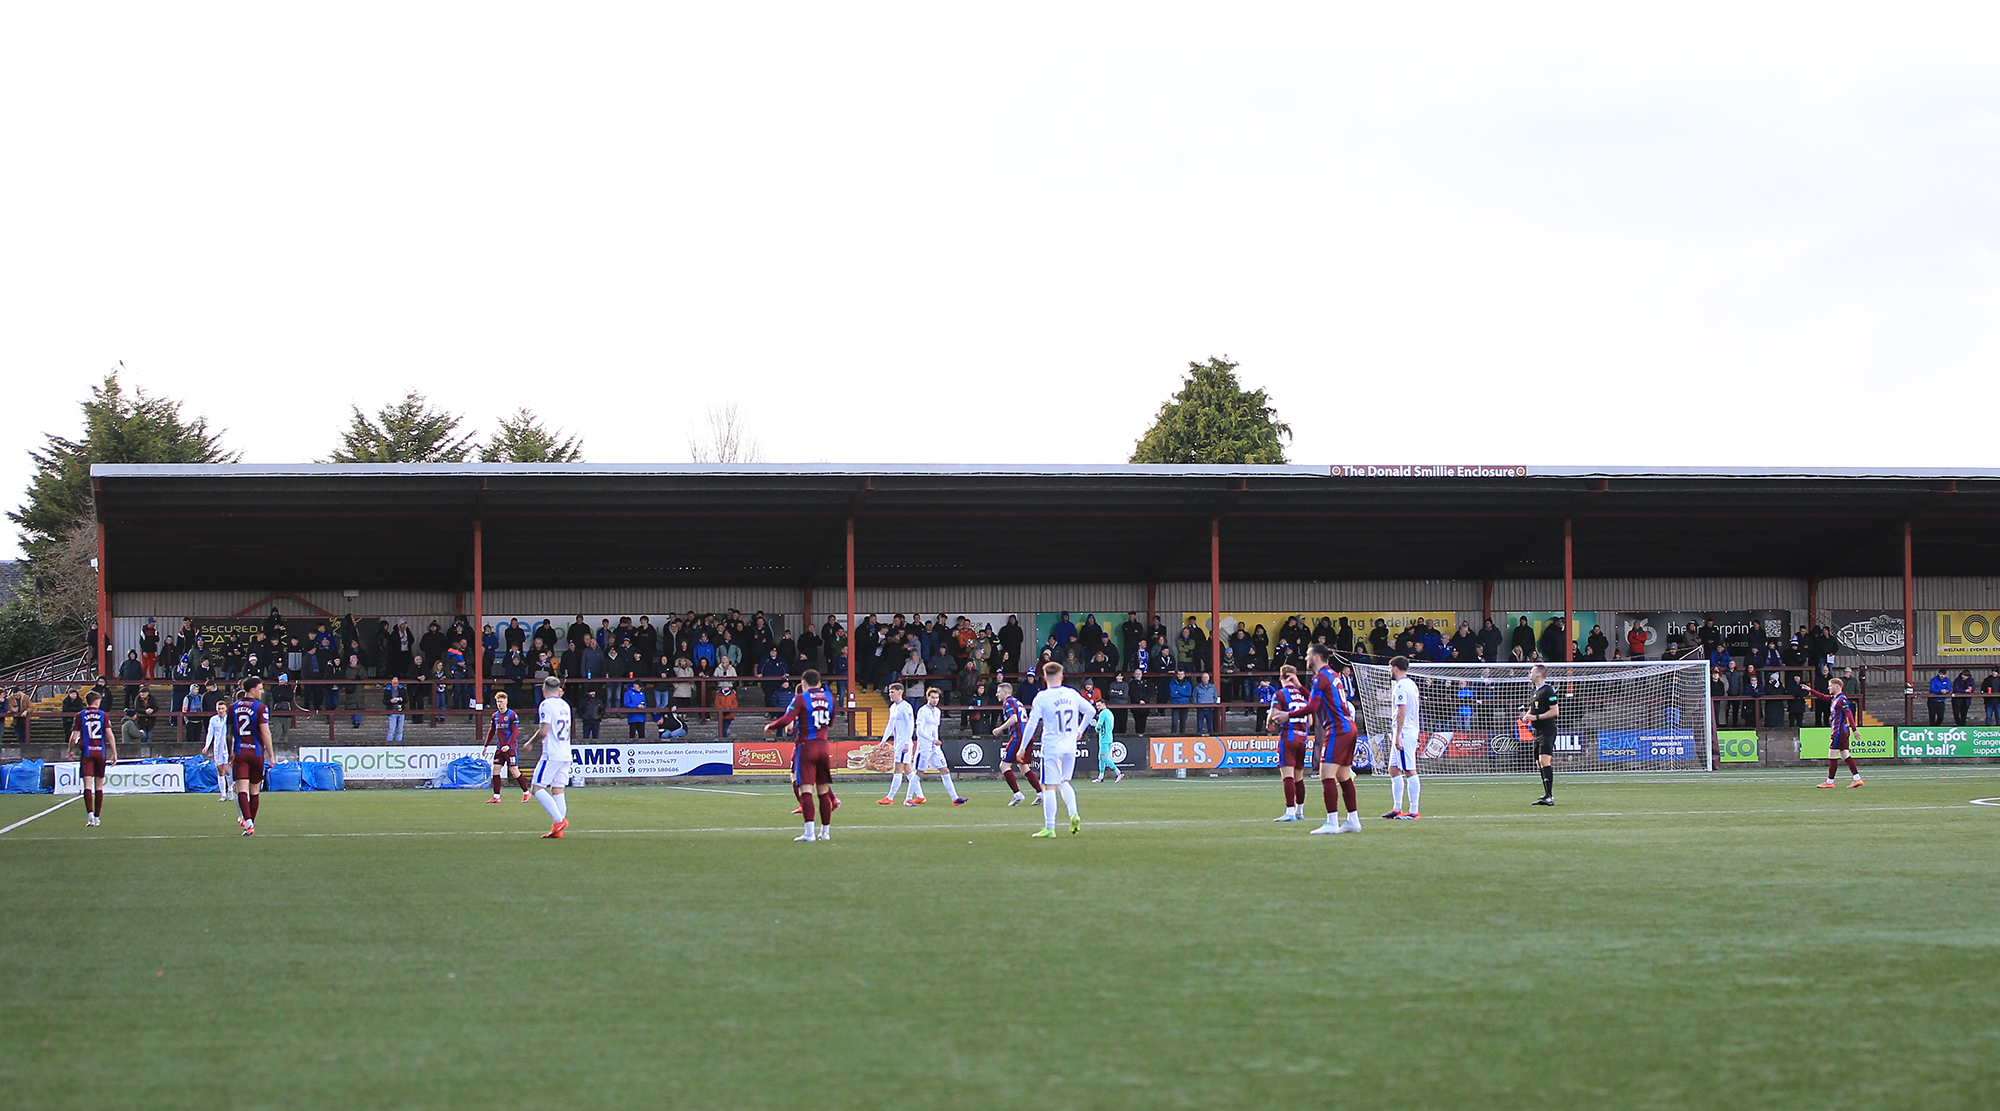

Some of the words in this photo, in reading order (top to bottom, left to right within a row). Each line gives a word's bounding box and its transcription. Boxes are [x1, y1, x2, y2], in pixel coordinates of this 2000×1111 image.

[1343, 466, 1365, 477] The
[1367, 466, 1411, 477] Donald
[1413, 466, 1455, 477] Smillie
[1457, 466, 1515, 477] Enclosure
[201, 625, 259, 633] SECURED
[1852, 623, 1876, 633] THE
[238, 714, 252, 735] 2
[812, 709, 831, 729] 14
[1055, 709, 1073, 732] 12
[85, 720, 102, 739] 12
[1900, 729, 1934, 742] Can't
[1938, 729, 1967, 743] spot
[1227, 739, 1249, 749] Your
[1599, 737, 1639, 749] RJM
[1900, 744, 1923, 755] the
[1926, 744, 1957, 755] ball?
[302, 749, 438, 772] allsportscm
[571, 749, 621, 765] AMR
[752, 751, 777, 761] Pepe's
[585, 766, 622, 774] CABINS
